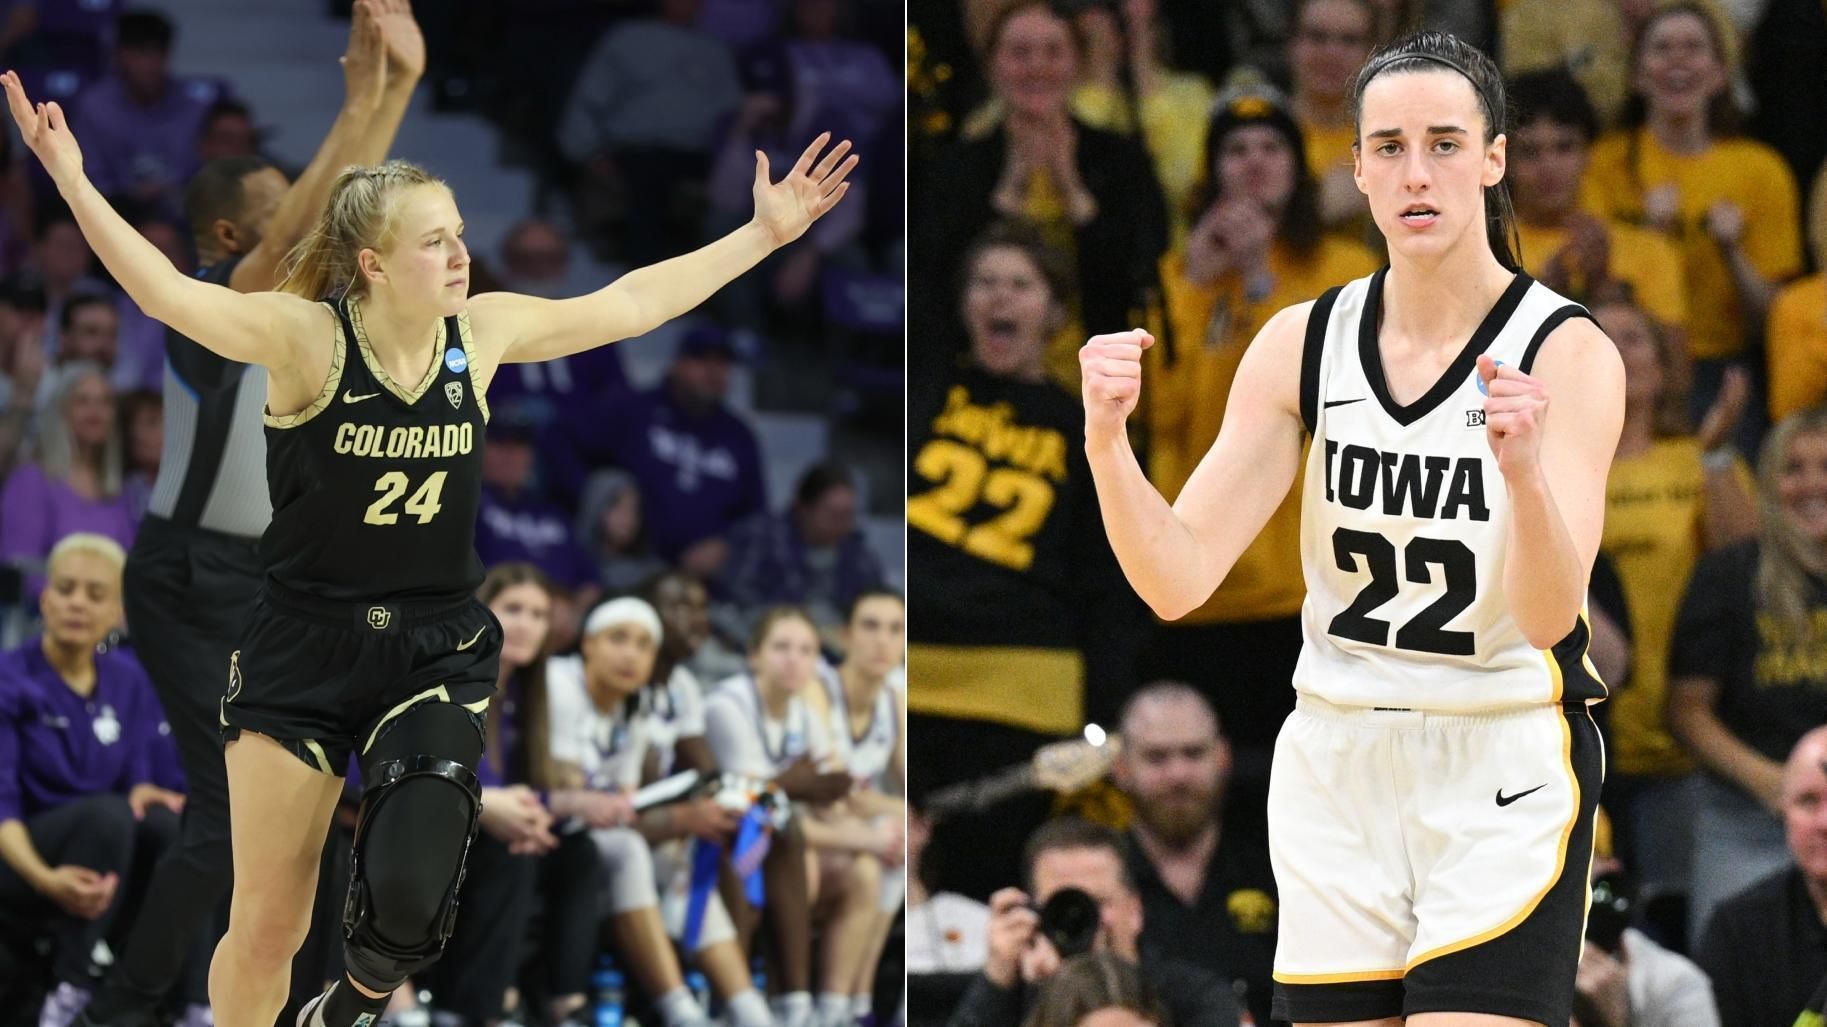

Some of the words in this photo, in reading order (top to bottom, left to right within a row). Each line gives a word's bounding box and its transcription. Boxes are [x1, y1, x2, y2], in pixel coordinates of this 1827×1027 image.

[333, 421, 473, 458] COLORADO
[1325, 438, 1490, 521] IOWA
[363, 471, 448, 525] 24
[908, 438, 1056, 571] 22
[1327, 526, 1477, 656] 22
